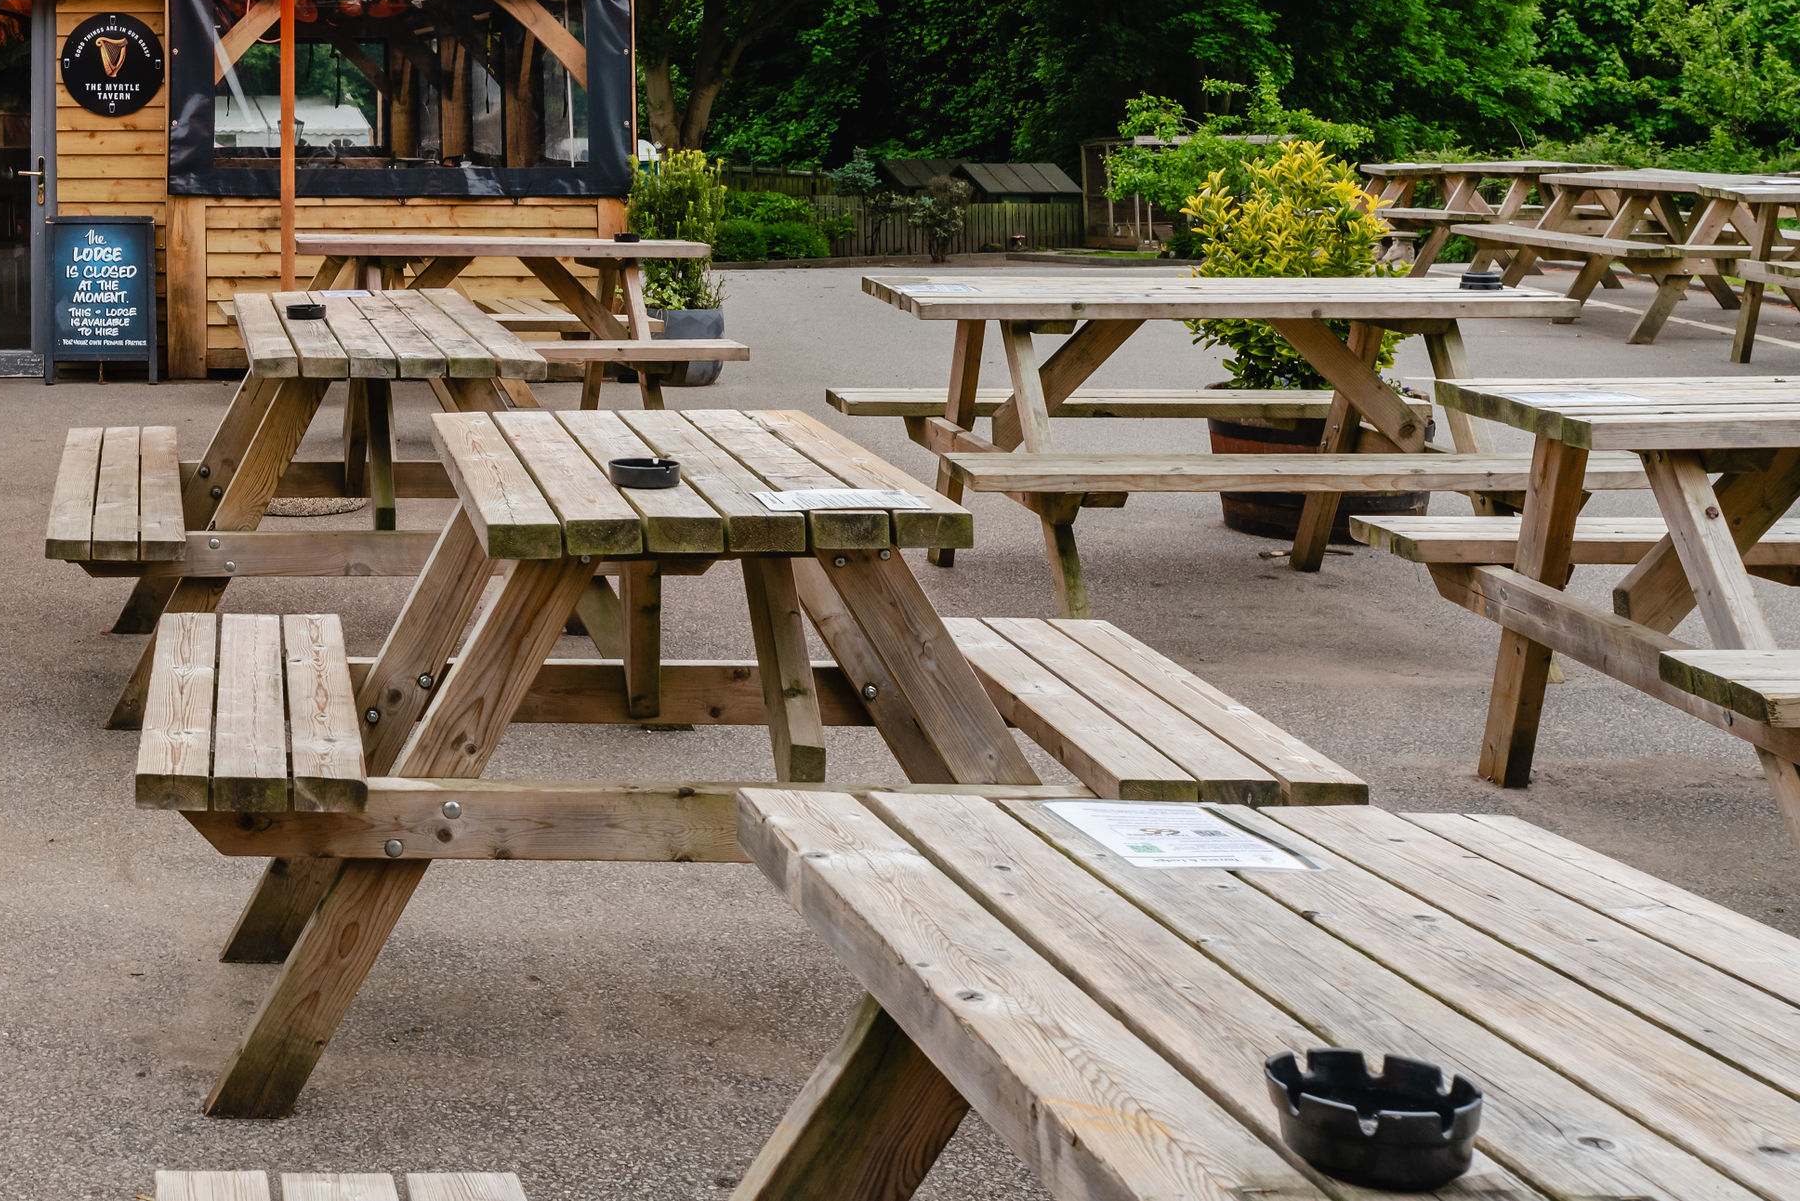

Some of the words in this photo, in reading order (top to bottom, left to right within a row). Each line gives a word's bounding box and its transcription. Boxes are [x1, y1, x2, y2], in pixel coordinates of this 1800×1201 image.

[75, 41, 85, 58] GOOD
[84, 27, 104, 42] THINGS
[127, 29, 139, 40] OUR
[138, 39, 151, 58] GRASP
[85, 83, 102, 91] THE
[105, 83, 140, 91] MYRTLE
[97, 92, 131, 100] TAVERN
[73, 246, 123, 262] LODGE
[66, 265, 79, 278] IS
[82, 265, 138, 278] CLOSED
[78, 280, 93, 291] AT
[96, 279, 120, 291] THE
[72, 291, 129, 304] MOMENT.
[68, 307, 91, 317] THIS
[105, 307, 137, 317] LODGE
[70, 318, 80, 327] IS
[81, 318, 130, 327] AVAILABLE
[77, 327, 92, 336] TO
[94, 327, 119, 337] HIRE
